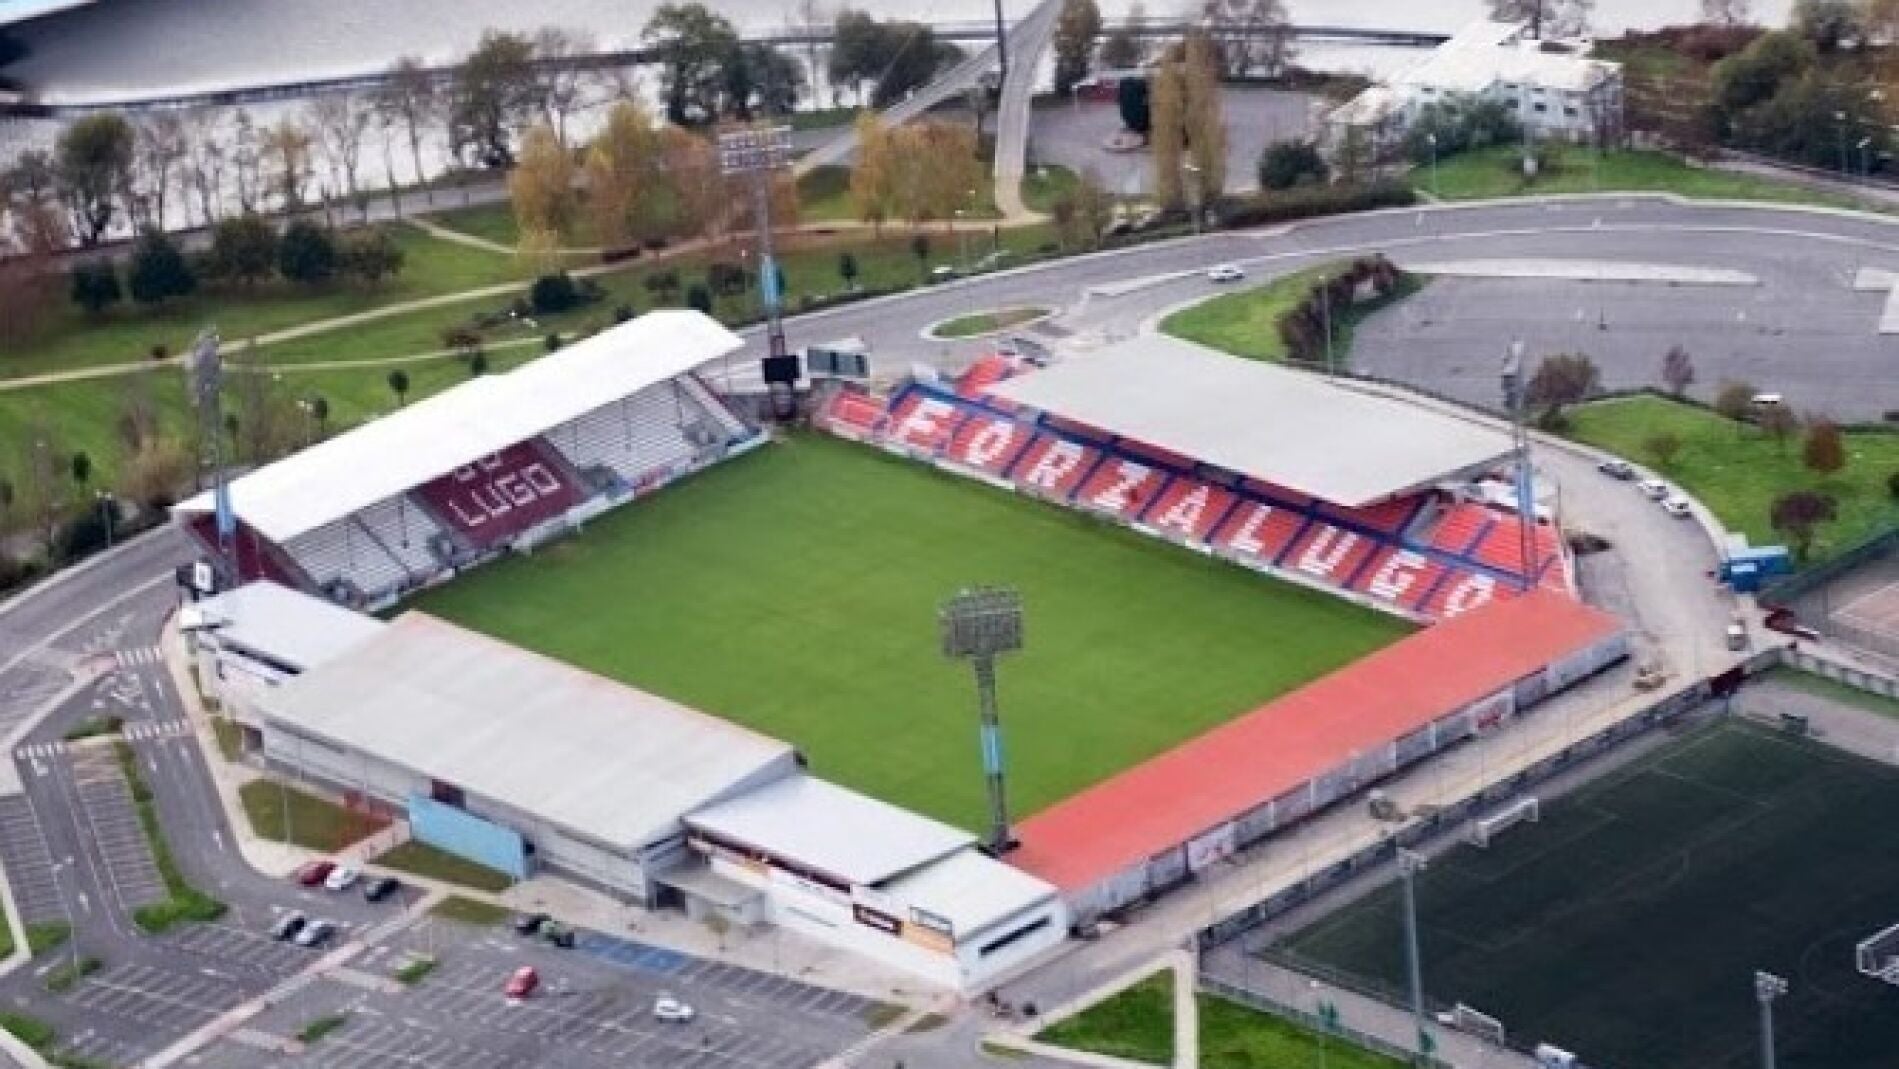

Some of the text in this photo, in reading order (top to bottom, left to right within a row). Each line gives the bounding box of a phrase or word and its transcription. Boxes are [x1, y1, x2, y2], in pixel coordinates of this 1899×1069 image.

[448, 463, 561, 527] LUGO
[891, 398, 1496, 618] FORZA LUGO
